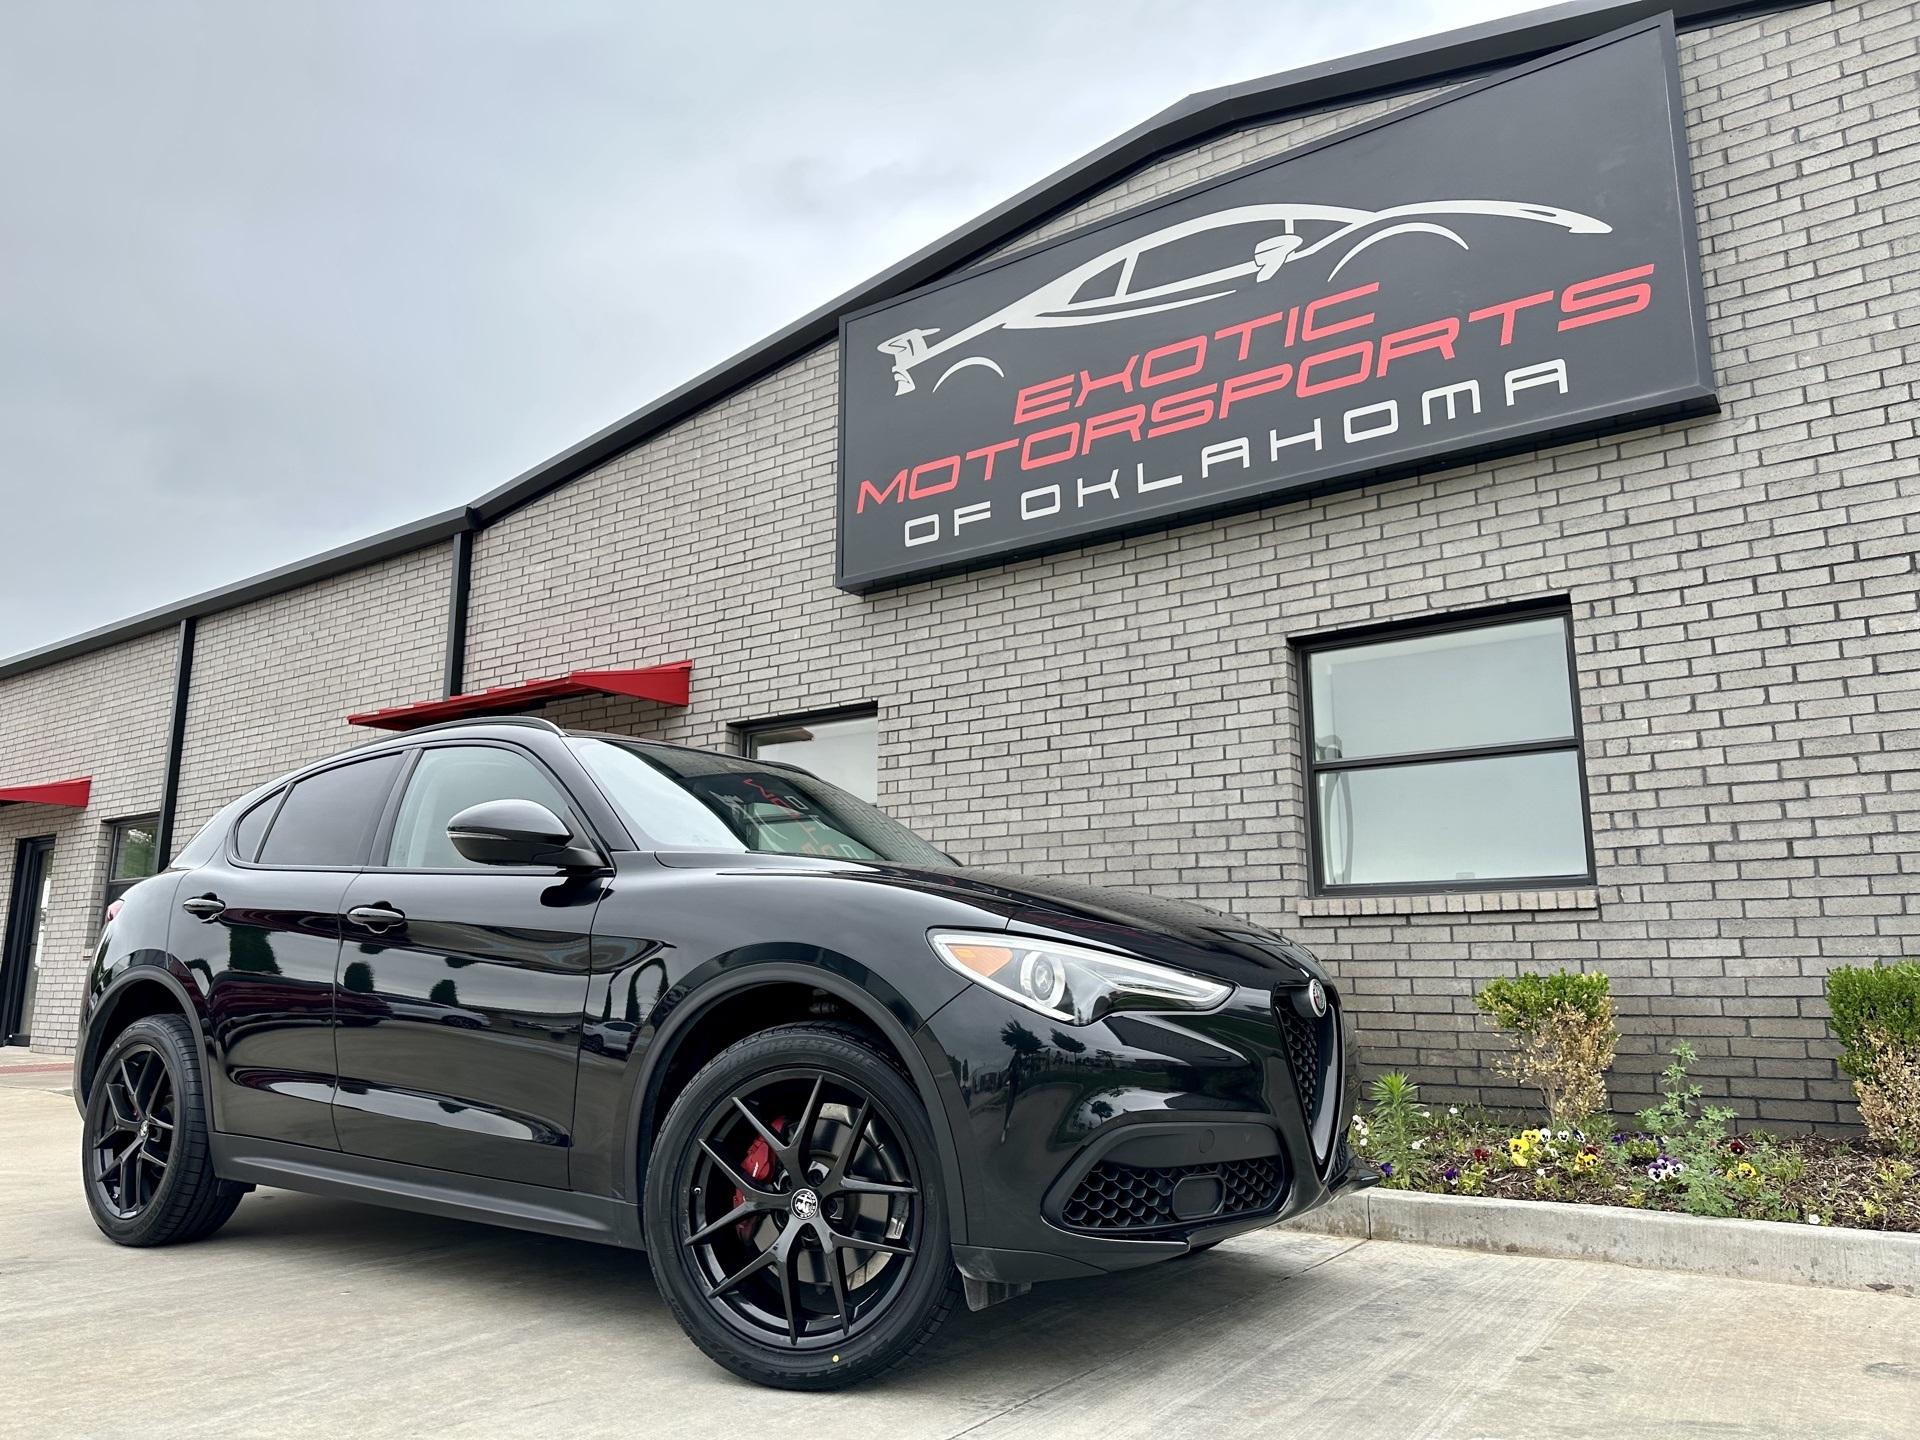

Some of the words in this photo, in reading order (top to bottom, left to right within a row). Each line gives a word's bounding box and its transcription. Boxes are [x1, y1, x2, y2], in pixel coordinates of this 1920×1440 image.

[856, 263, 1656, 515] MOTORSPORTS
[1014, 281, 1380, 425] EXOTIC
[903, 499, 993, 549] OF
[1019, 357, 1570, 522] OKLAHOMA
